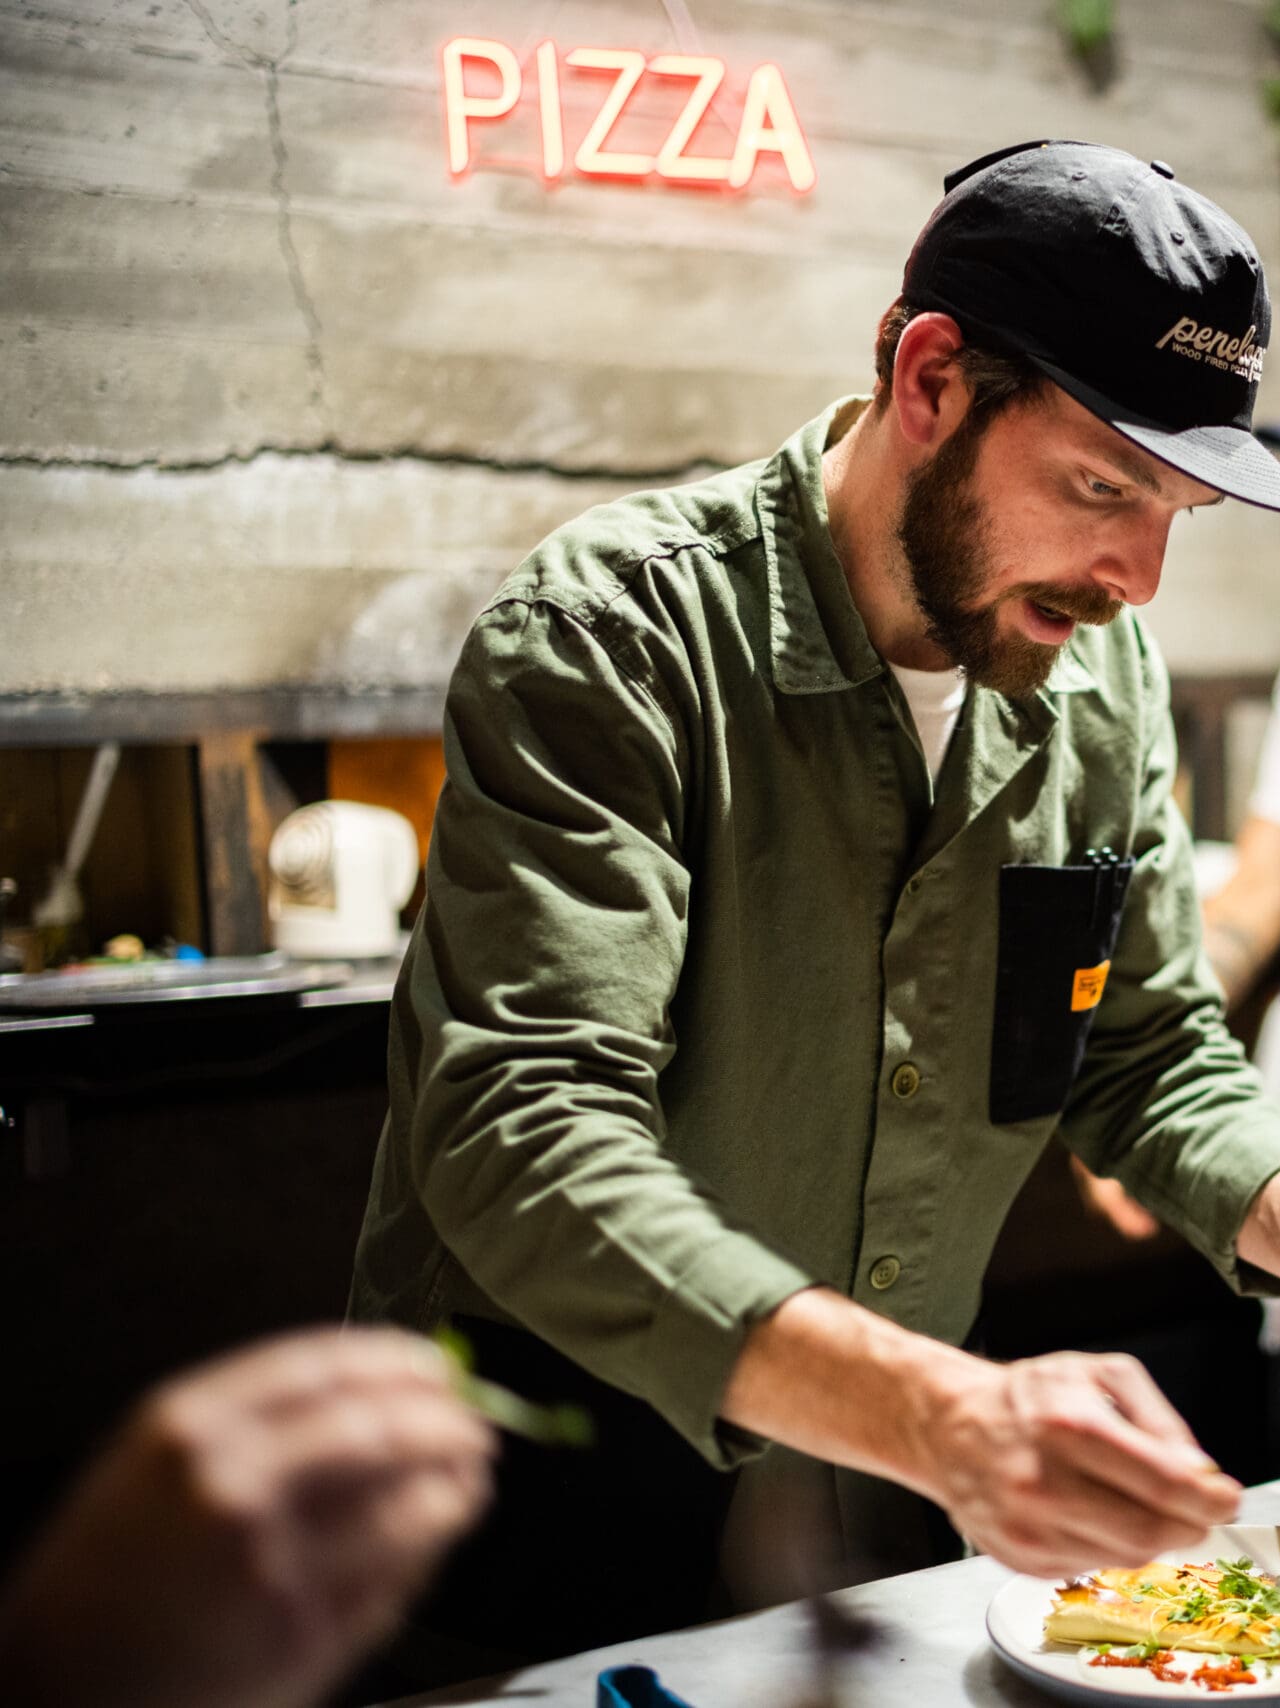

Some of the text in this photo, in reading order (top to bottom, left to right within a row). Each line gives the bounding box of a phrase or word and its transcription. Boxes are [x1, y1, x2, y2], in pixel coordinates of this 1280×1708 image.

[443, 37, 815, 192] PIZZA
[1172, 343, 1202, 361] WOOD
[1205, 356, 1229, 370] FIRED
